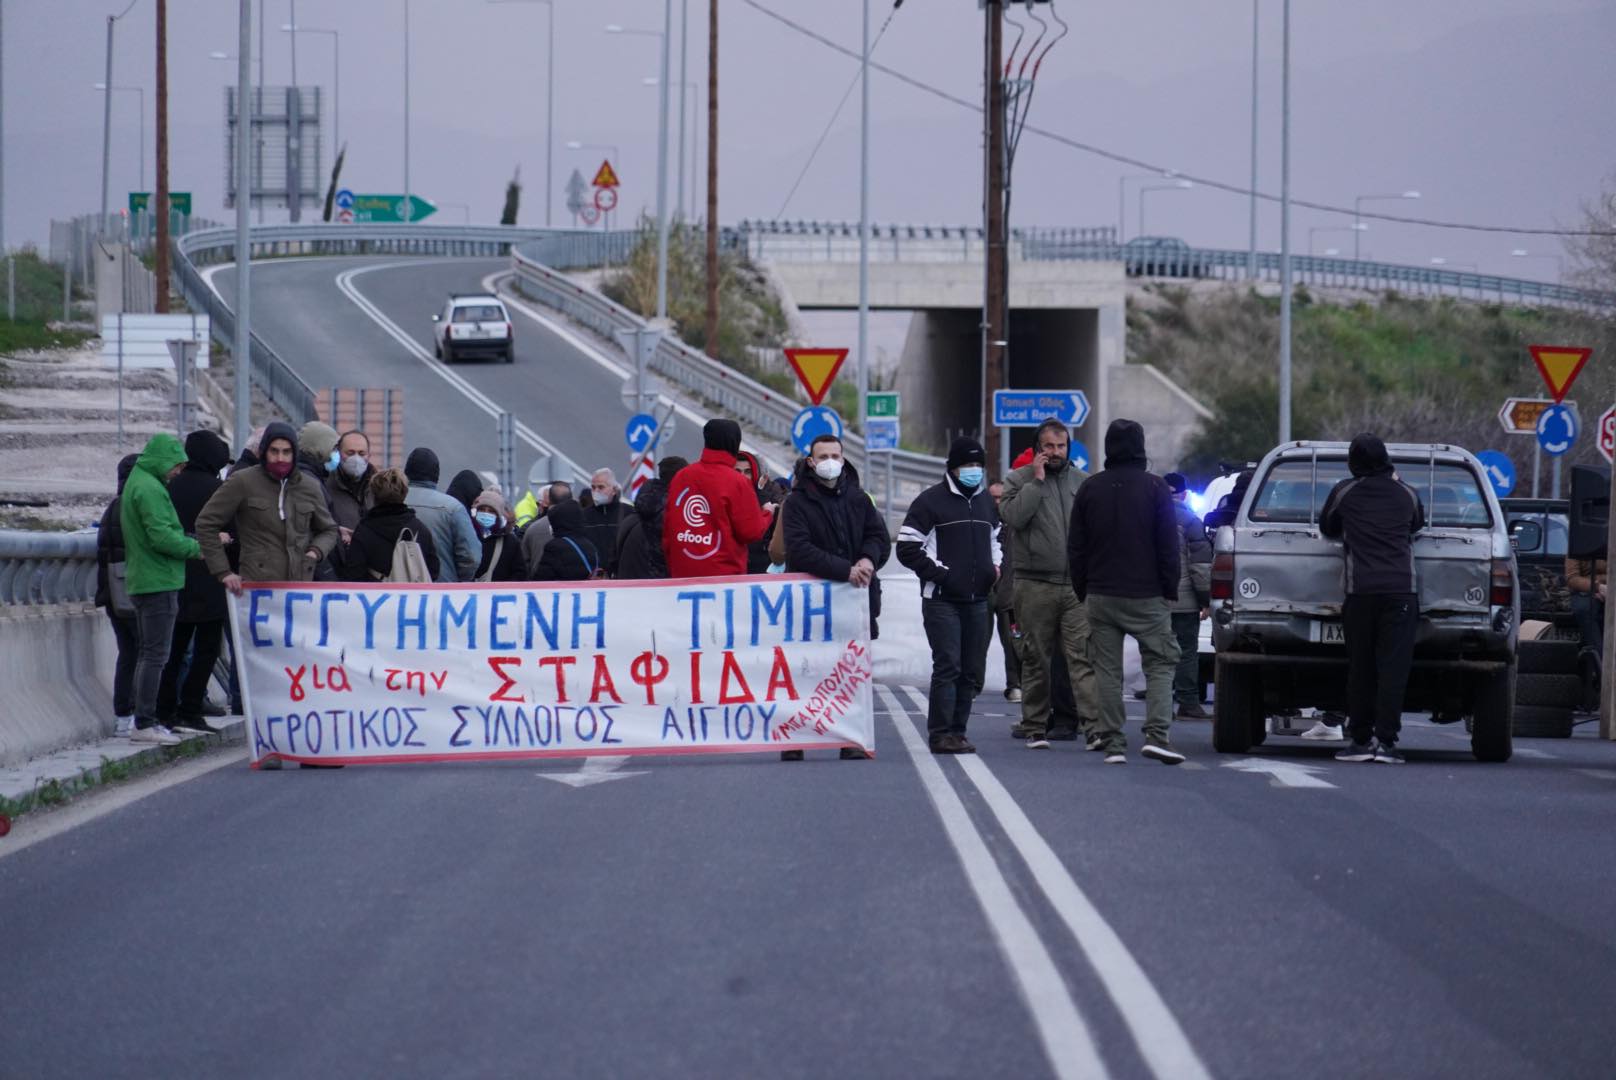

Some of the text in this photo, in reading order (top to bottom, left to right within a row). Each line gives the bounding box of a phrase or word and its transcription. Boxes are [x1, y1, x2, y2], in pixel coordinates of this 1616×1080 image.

[1000, 409, 1059, 420] Local Road
[676, 530, 713, 545] efood
[1242, 582, 1257, 594] 90
[250, 581, 833, 651] ΕΓΓΥΗΜΕΝΗ ΤΙΜΗ
[284, 645, 801, 706] για την ΣΤΑΦΙΔΑ
[254, 703, 777, 757] ΑΓΡΟΤΙΚΟΣ ΣΥΛΛΟΓΟΣ ΑΙΓΙΟΥ
